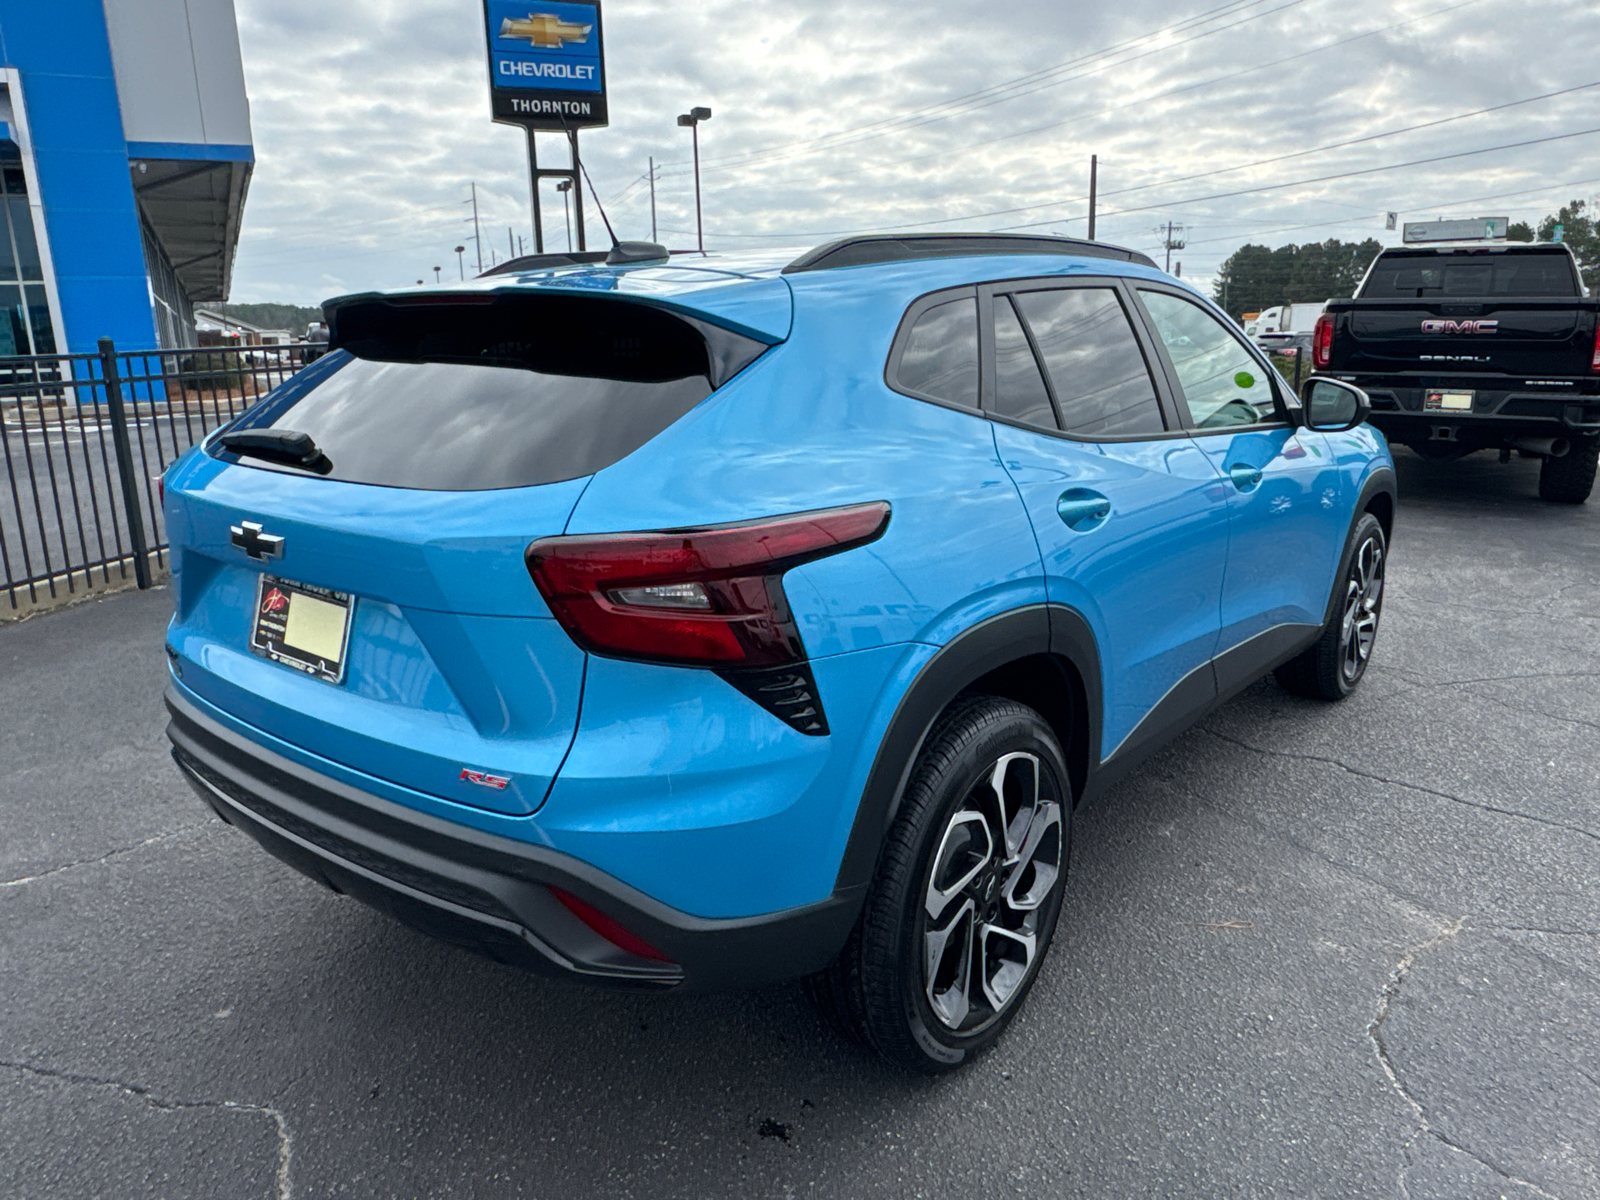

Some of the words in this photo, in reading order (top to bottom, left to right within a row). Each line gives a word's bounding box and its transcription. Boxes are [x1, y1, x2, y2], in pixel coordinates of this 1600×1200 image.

[500, 60, 595, 80] CHEVROLET
[511, 98, 591, 115] THORNTON
[1421, 319, 1499, 334] GMC
[1419, 354, 1491, 363] DENALI
[459, 767, 512, 790] RS
